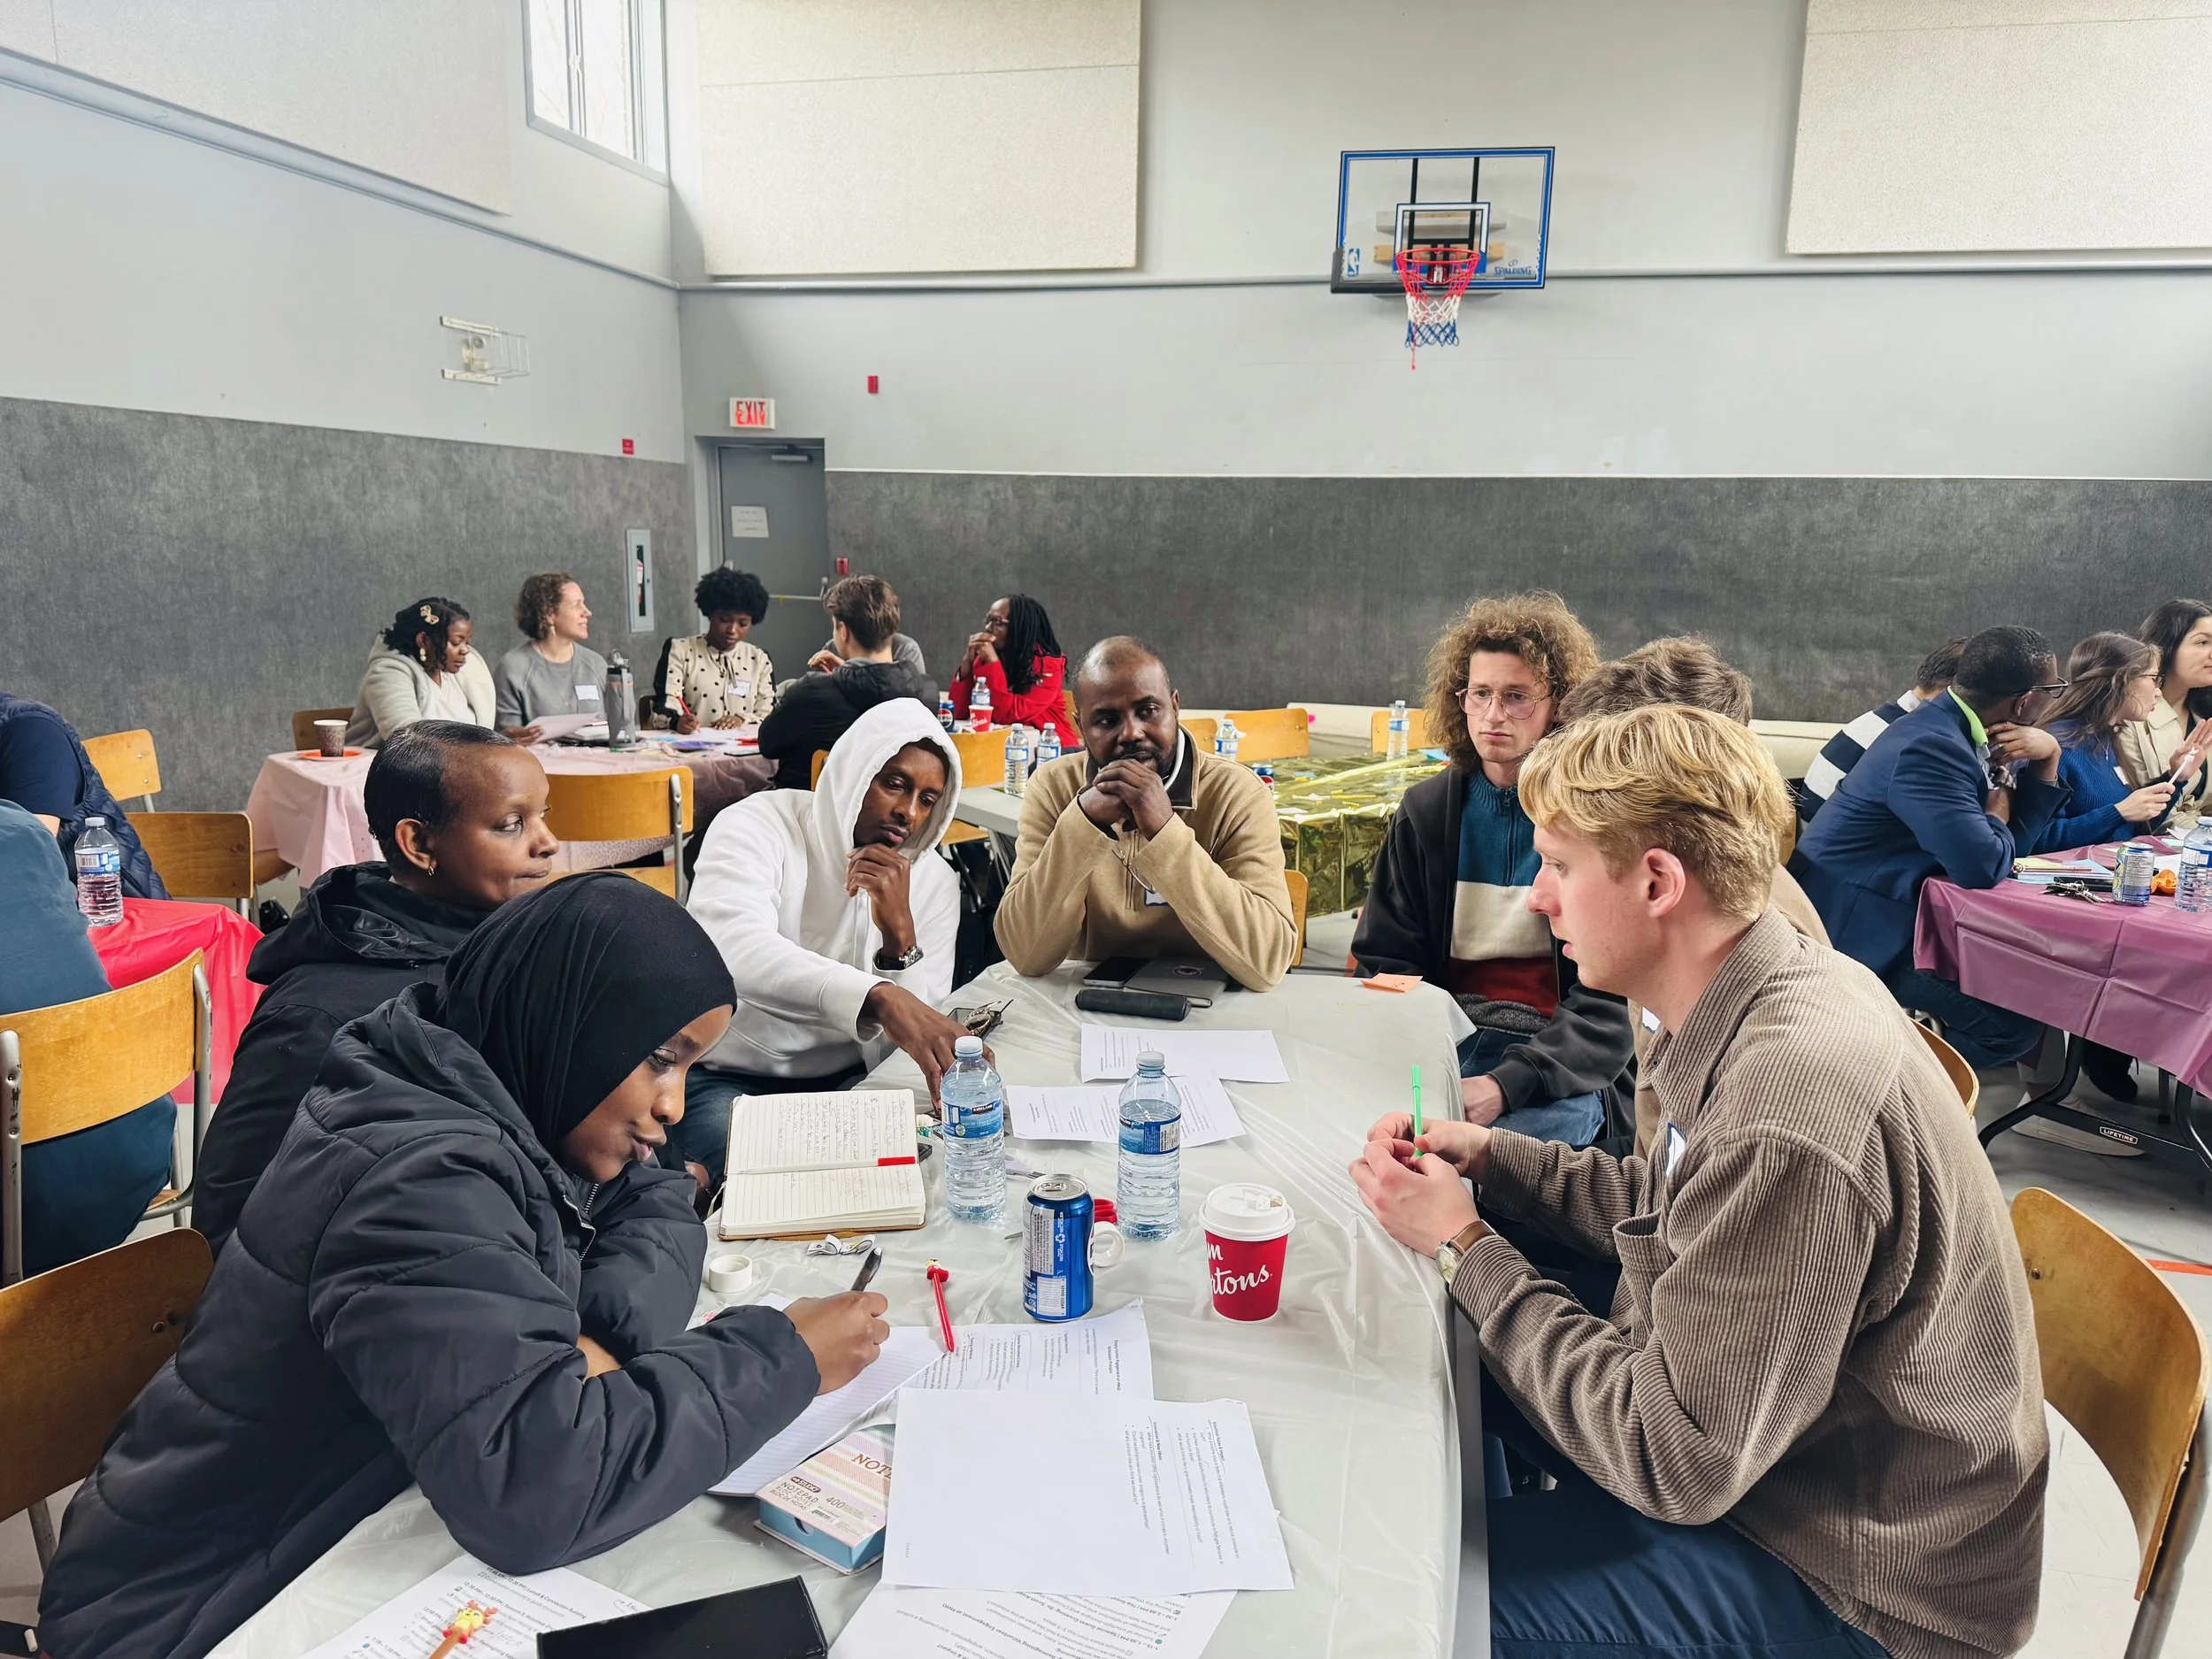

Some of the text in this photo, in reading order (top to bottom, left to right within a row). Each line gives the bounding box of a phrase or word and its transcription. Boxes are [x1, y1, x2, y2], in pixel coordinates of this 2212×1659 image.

[1494, 265, 1532, 276] SPALDING
[735, 401, 765, 426] EXIT
[2103, 1129, 2134, 1142] LIFETIME
[780, 1482, 818, 1502] NOTEPAD
[826, 1497, 845, 1509] 400
[963, 1613, 995, 1631] Engagement
[995, 1629, 1021, 1644] Volunteer
[1096, 1627, 1117, 1636] Special
